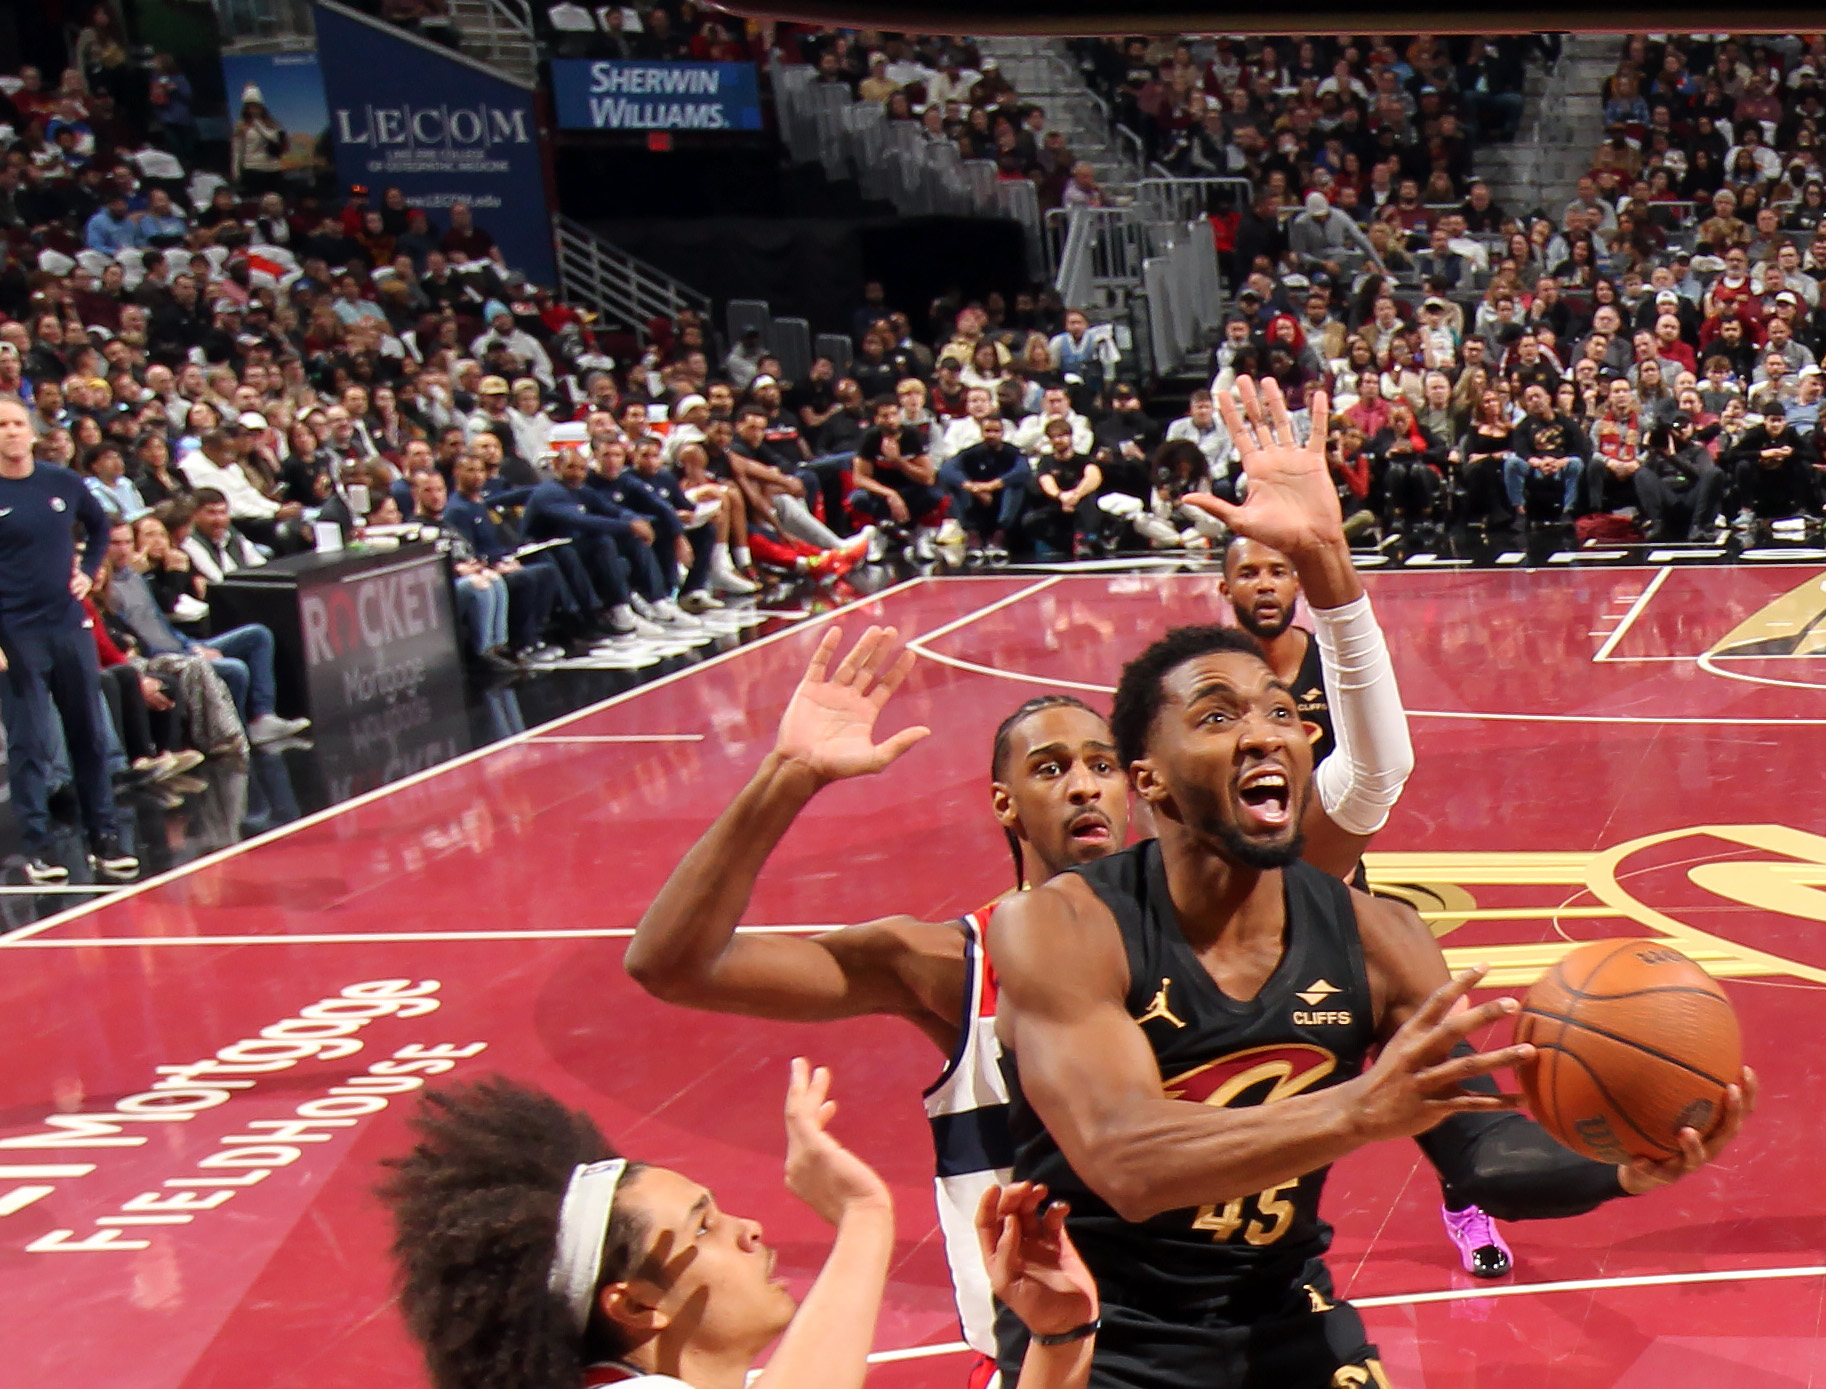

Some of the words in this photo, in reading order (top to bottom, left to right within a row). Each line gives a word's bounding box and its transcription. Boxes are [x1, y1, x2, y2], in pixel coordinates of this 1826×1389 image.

[589, 61, 720, 94] SHERWIN
[336, 105, 529, 146] LECOM
[588, 98, 724, 128] WILLIAMS
[302, 565, 443, 666] ROCKET
[1293, 1011, 1352, 1026] CLIFFS
[25, 1041, 488, 1253] FIELDHOUSE
[1192, 1177, 1299, 1247] 45
